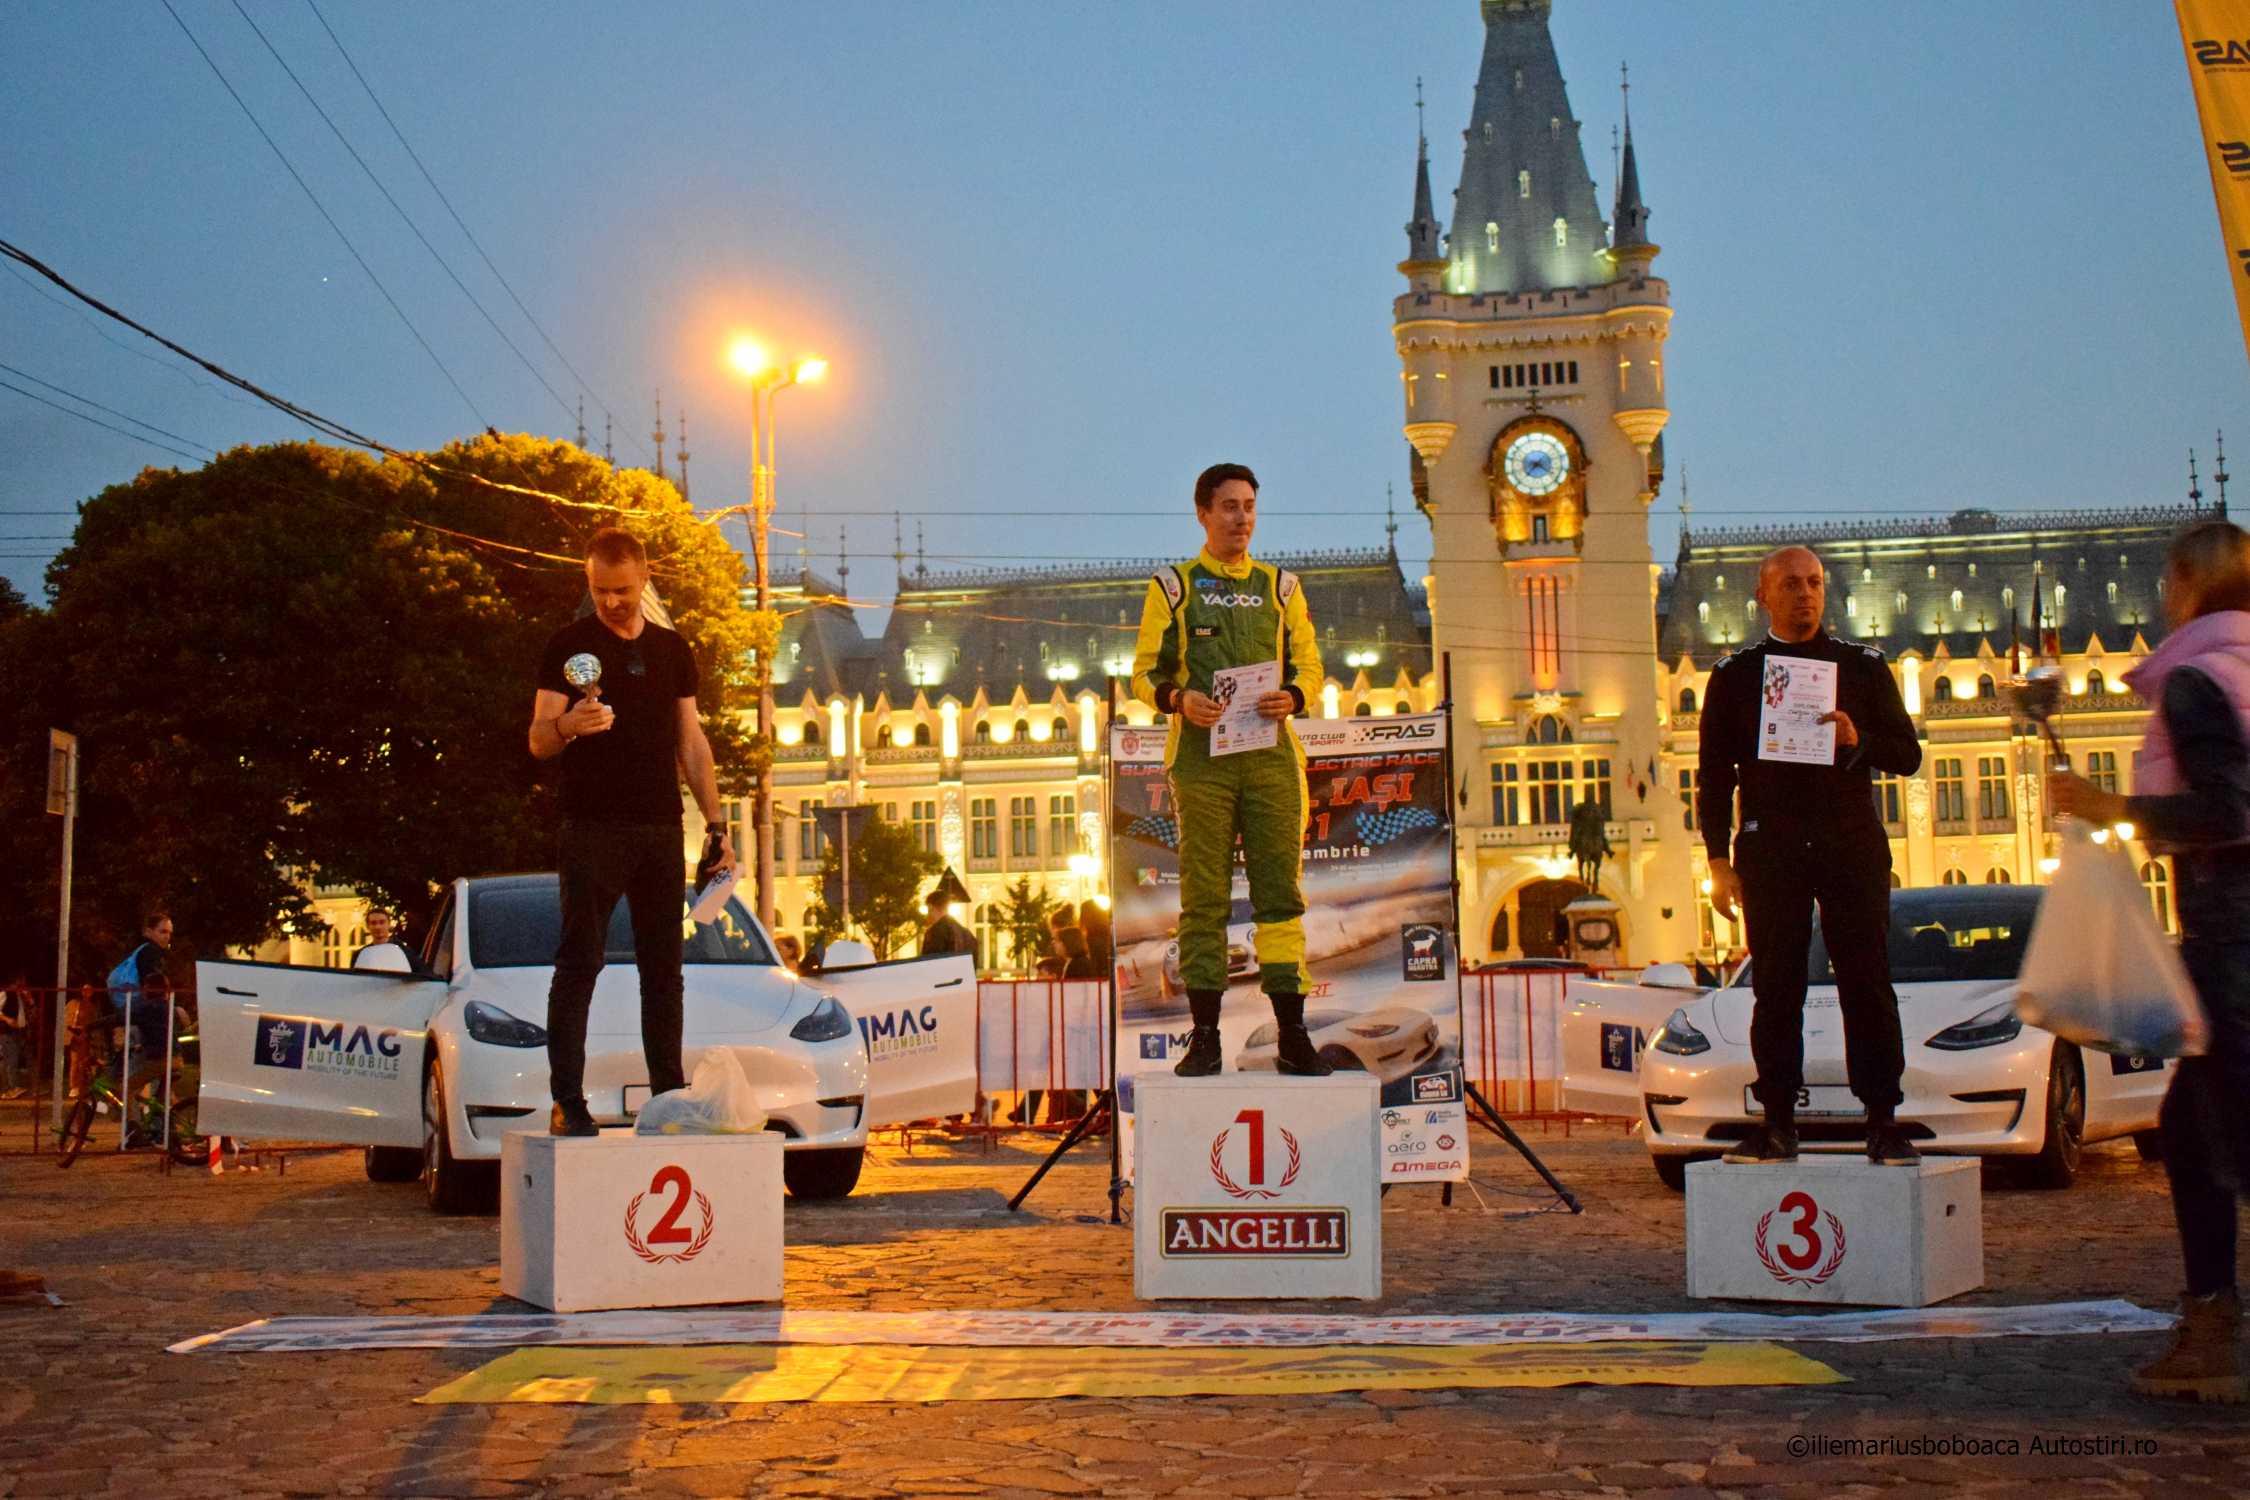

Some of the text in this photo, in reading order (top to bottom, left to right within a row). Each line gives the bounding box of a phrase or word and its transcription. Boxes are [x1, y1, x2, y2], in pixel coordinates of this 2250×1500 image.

[1200, 593, 1263, 608] YACCO
[1298, 733, 1318, 741] UTO
[1369, 723, 1436, 741] FRAS
[1385, 751, 1441, 767] RACE
[1302, 844, 1371, 860] embrie
[870, 1006, 937, 1041] MAG
[309, 1022, 401, 1057] MAG
[873, 1032, 938, 1053] AUTOMOBILE
[307, 1050, 400, 1072] AUTOMOBILE
[1234, 1109, 1265, 1185] 1
[1387, 1141, 1426, 1153] aero
[647, 1165, 692, 1244] 2
[1168, 1218, 1341, 1249] ANGELLI
[1776, 1191, 1822, 1270] 3
